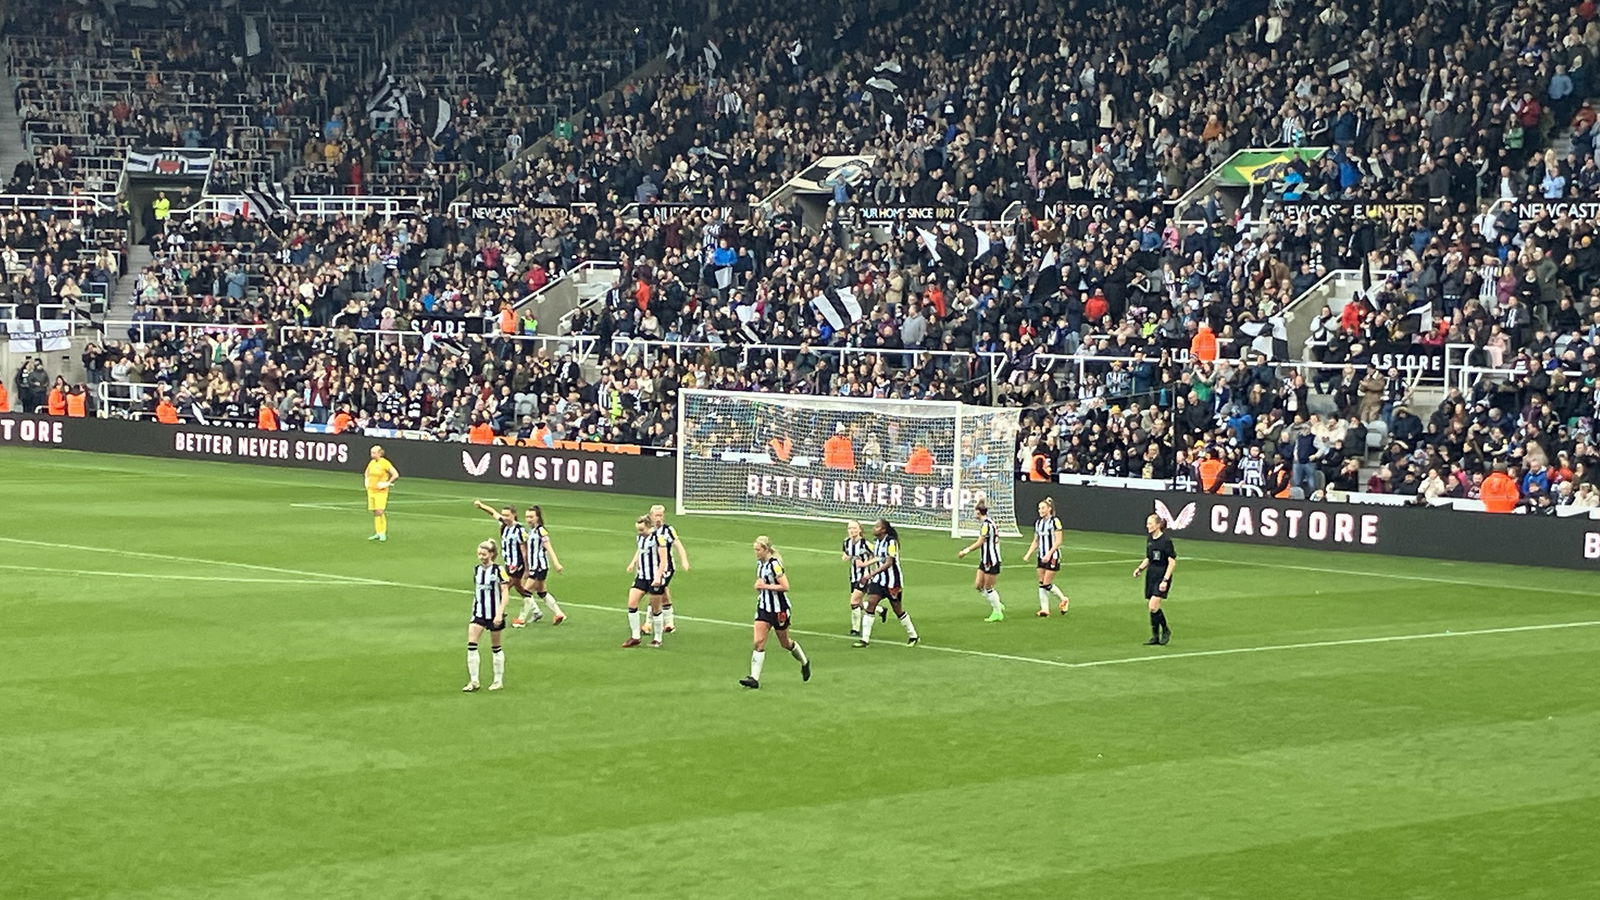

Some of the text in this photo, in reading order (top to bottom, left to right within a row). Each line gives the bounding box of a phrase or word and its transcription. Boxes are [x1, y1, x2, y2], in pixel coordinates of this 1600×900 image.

[472, 207, 526, 219] NEWCAST
[907, 207, 934, 219] SINCE
[1519, 203, 1600, 219] NEWCAST
[175, 432, 349, 463] BETTER NEVER STOPS
[500, 453, 615, 486] CASTORE
[747, 474, 823, 499] BETTER
[833, 479, 902, 506] NEVER
[1211, 504, 1378, 545] CASTORE
